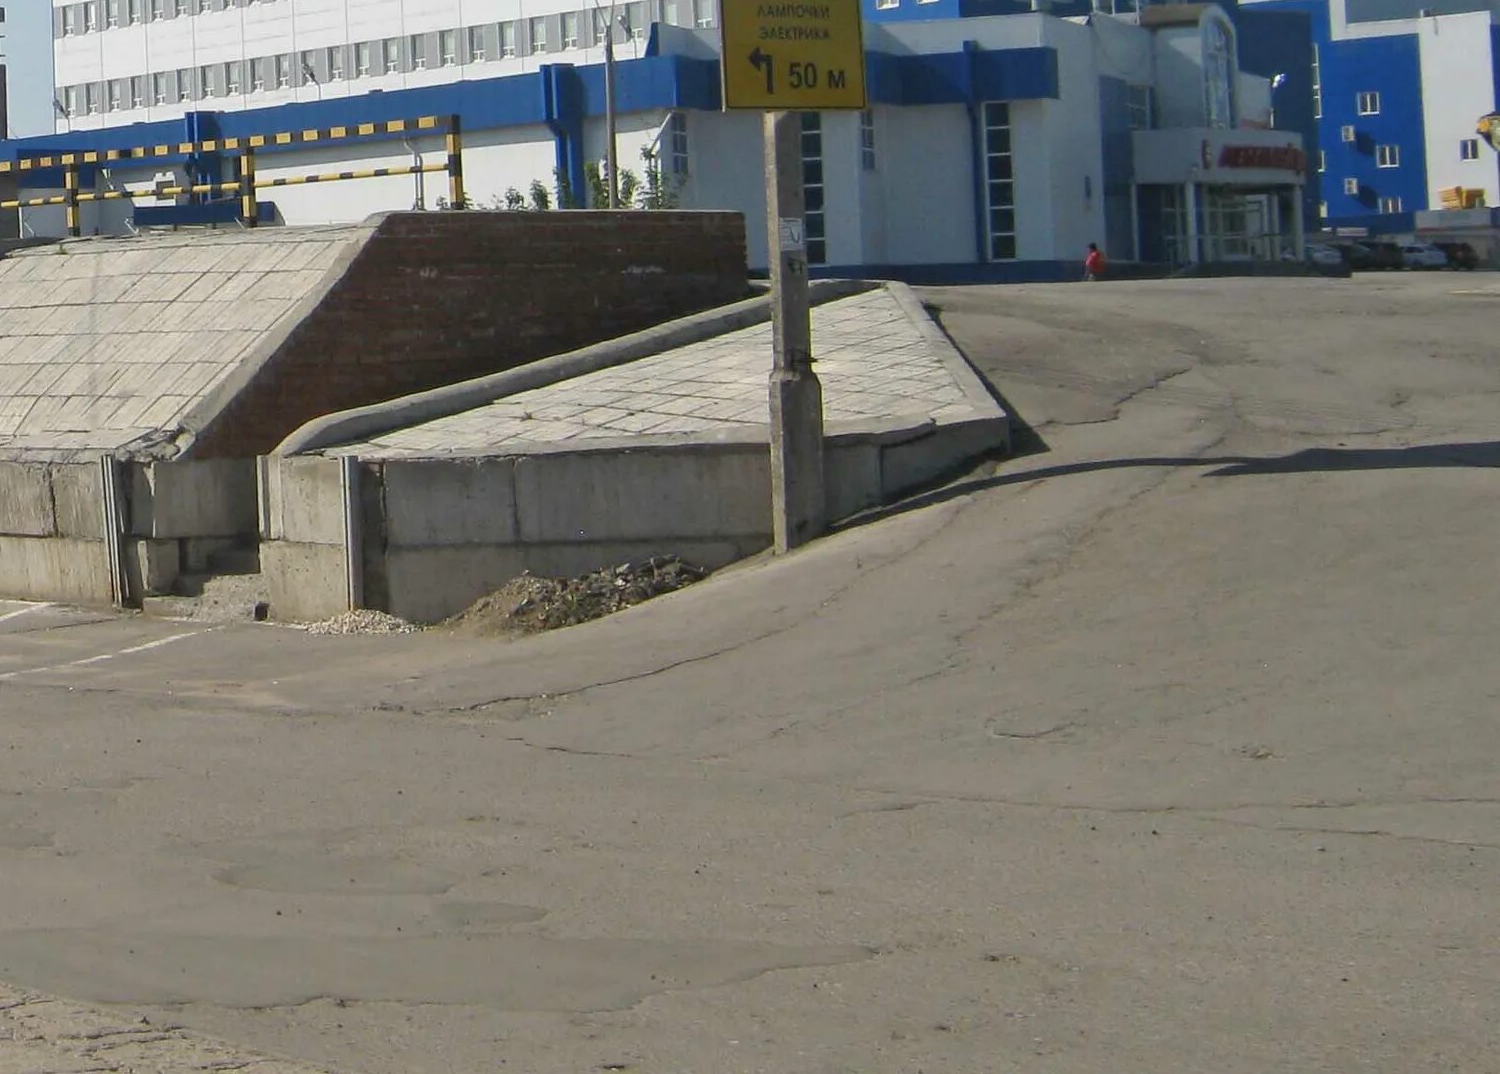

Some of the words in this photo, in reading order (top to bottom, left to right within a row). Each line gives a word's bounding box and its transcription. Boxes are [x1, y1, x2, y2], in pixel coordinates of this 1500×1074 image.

[757, 4, 830, 18] ЛАМПОЧКИ
[759, 25, 830, 40] ЭЛЕКТРИКА
[788, 61, 817, 89] 50
